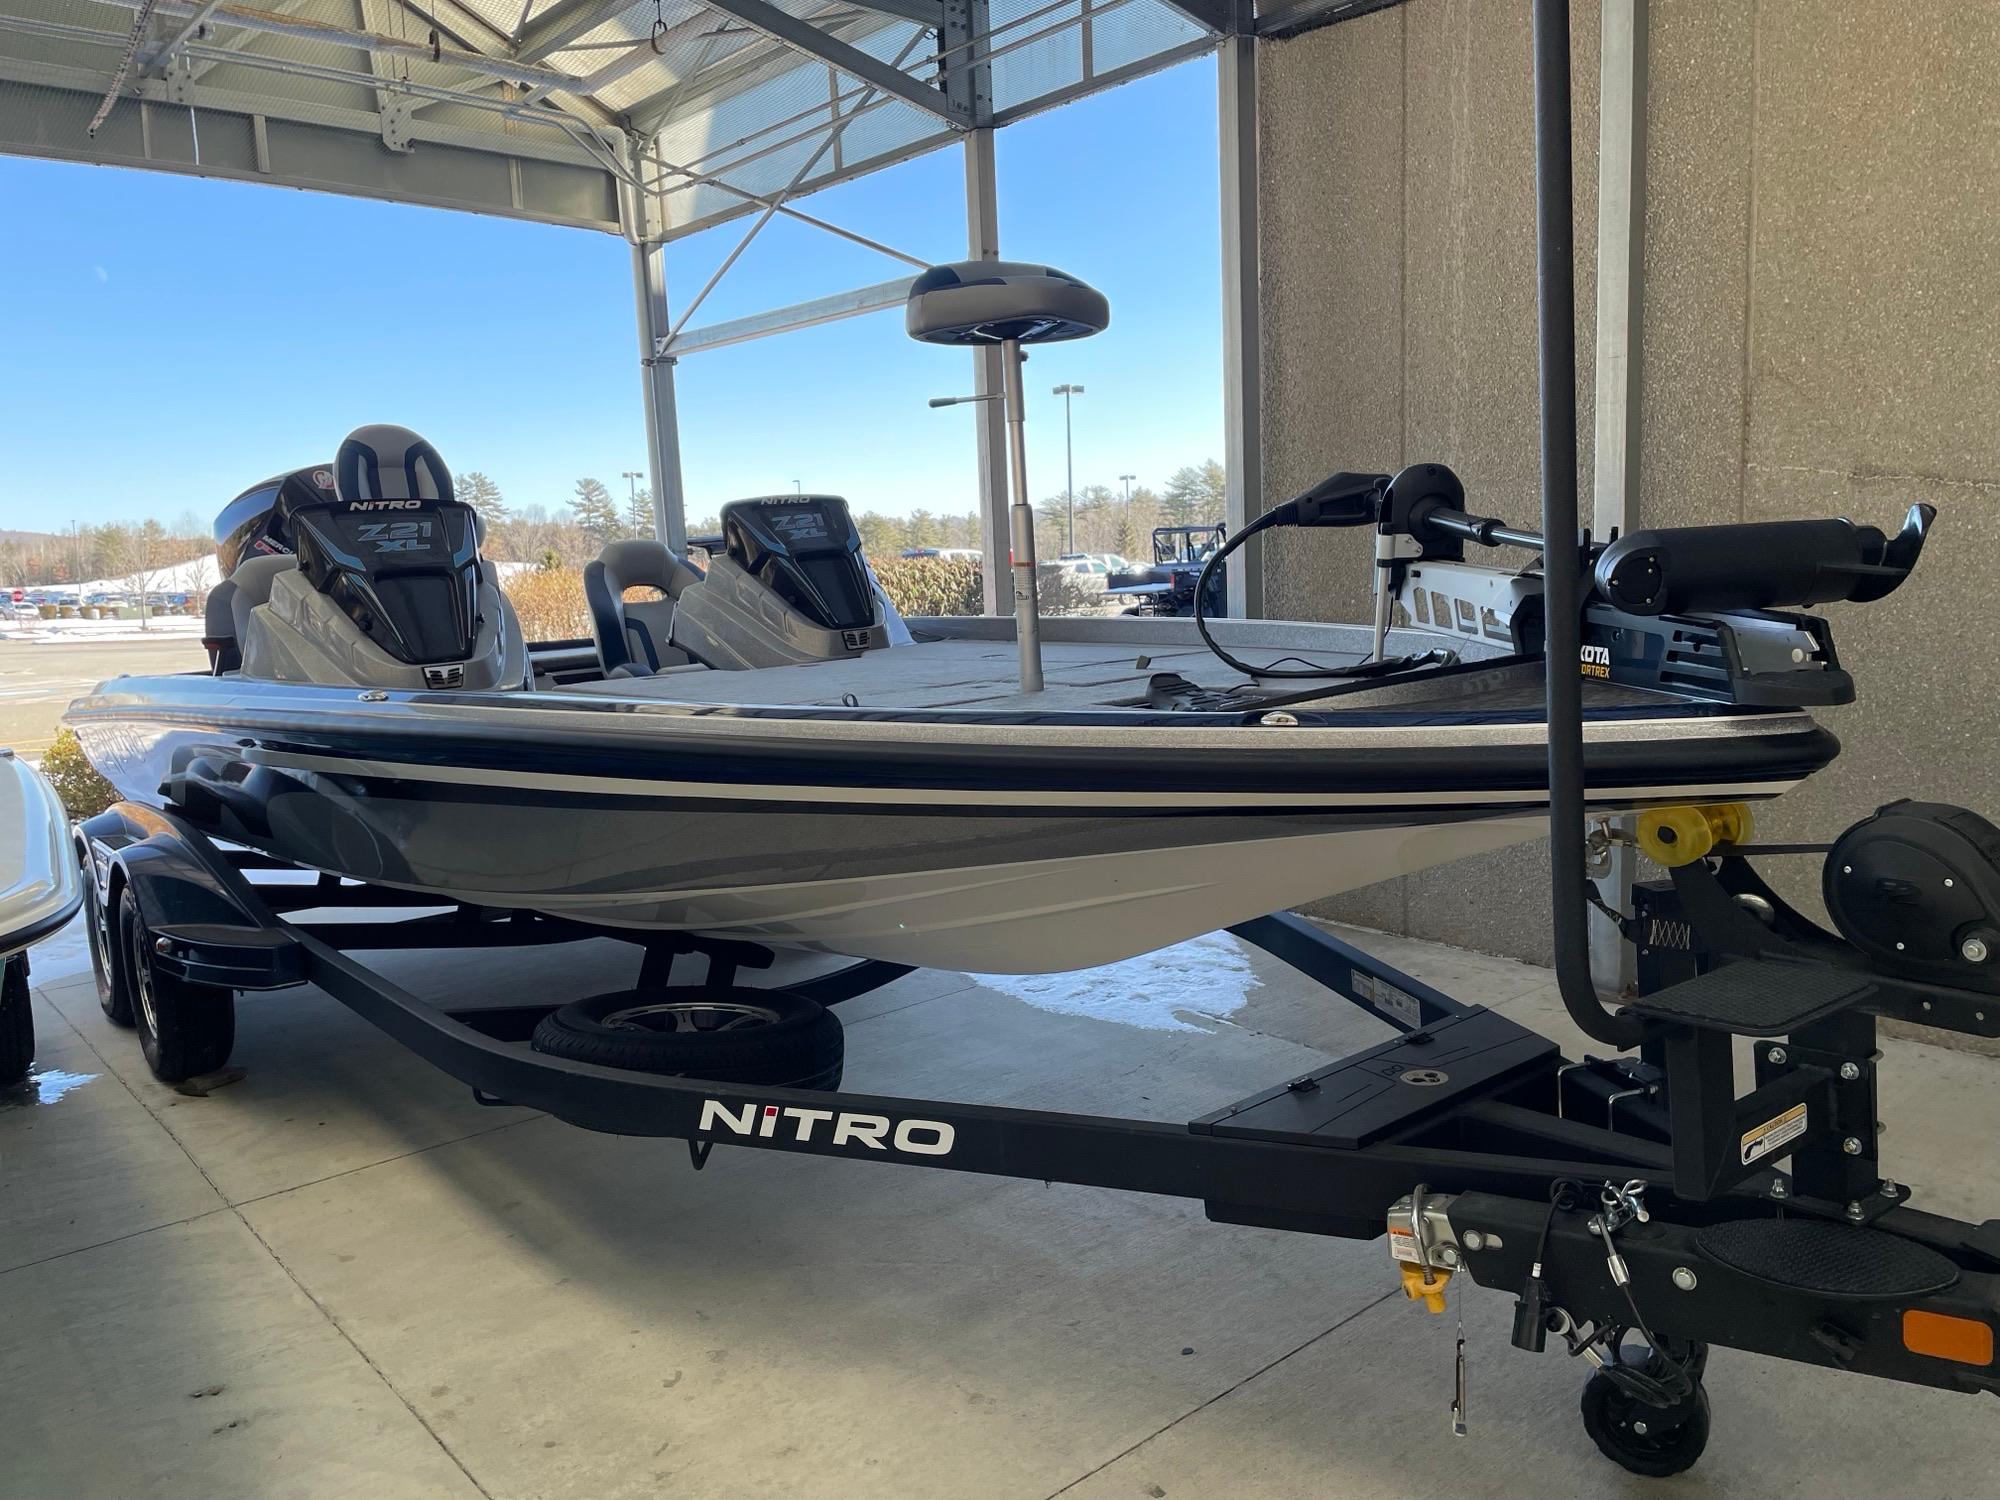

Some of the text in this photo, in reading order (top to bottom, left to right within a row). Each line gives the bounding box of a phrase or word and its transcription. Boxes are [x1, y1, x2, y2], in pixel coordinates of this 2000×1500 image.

[358, 521, 432, 541] Z21
[772, 513, 824, 531] Z21
[374, 540, 430, 552] XL
